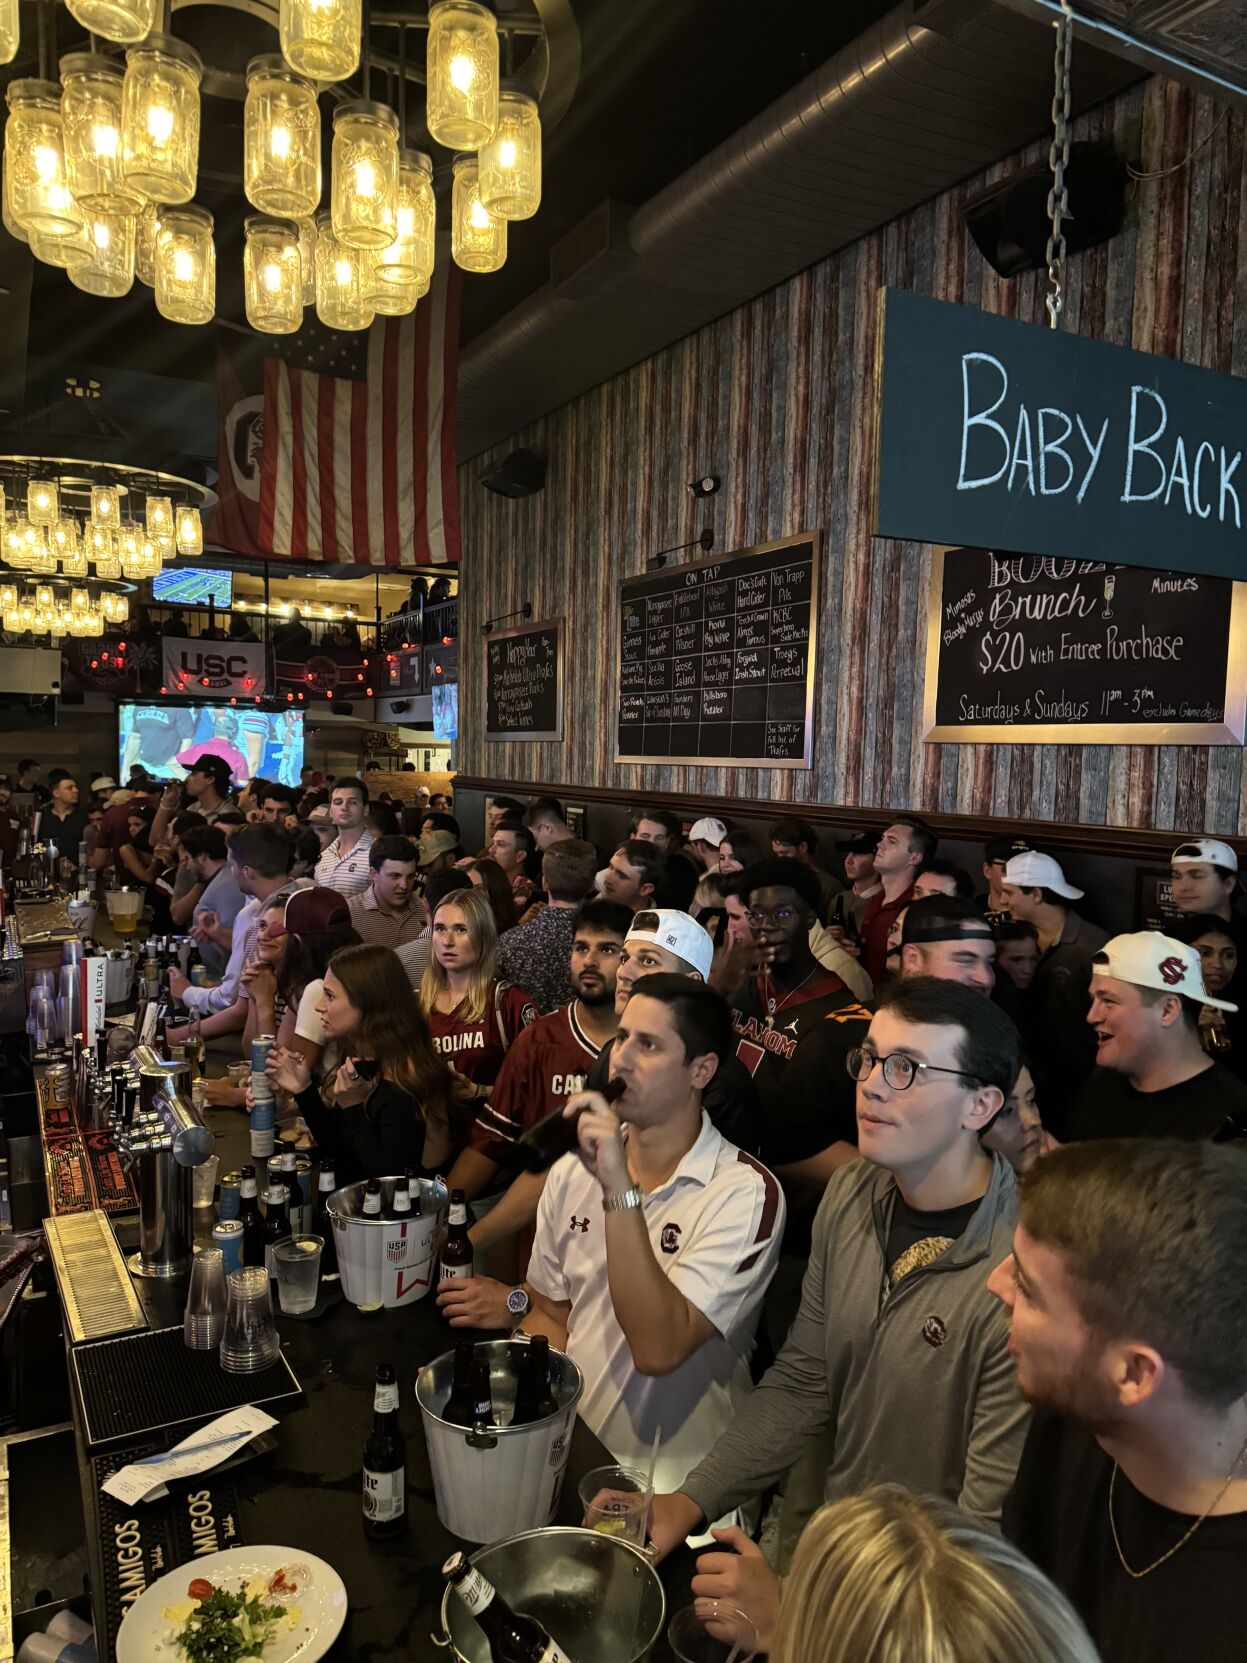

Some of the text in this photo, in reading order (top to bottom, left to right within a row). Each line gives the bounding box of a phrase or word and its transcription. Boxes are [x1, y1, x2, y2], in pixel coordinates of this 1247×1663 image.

[685, 565, 721, 586] ON TAP
[772, 568, 805, 587] Von Trapp
[987, 552, 1127, 589] BOO
[778, 587, 792, 603] Pils
[1151, 577, 1199, 594] Minutes
[737, 591, 766, 608] Hard Cider
[945, 588, 977, 620] Mimosas
[988, 583, 1099, 630] Brunch
[943, 622, 967, 647] Bloody
[979, 624, 1184, 675] $20 With Entree Purchase
[181, 651, 248, 678] USC
[675, 659, 693, 671] Goose
[749, 665, 766, 678] Stout
[675, 669, 696, 687] Island
[680, 704, 691, 719] Day
[958, 690, 1020, 725] Saturdays
[1022, 698, 1032, 717] &
[1034, 688, 1090, 723] Sundays
[96, 963, 104, 997] ULTRA
[432, 1031, 485, 1054] ROLINA
[187, 1490, 218, 1556] MIGOS
[114, 1519, 146, 1610] AMIGOS
